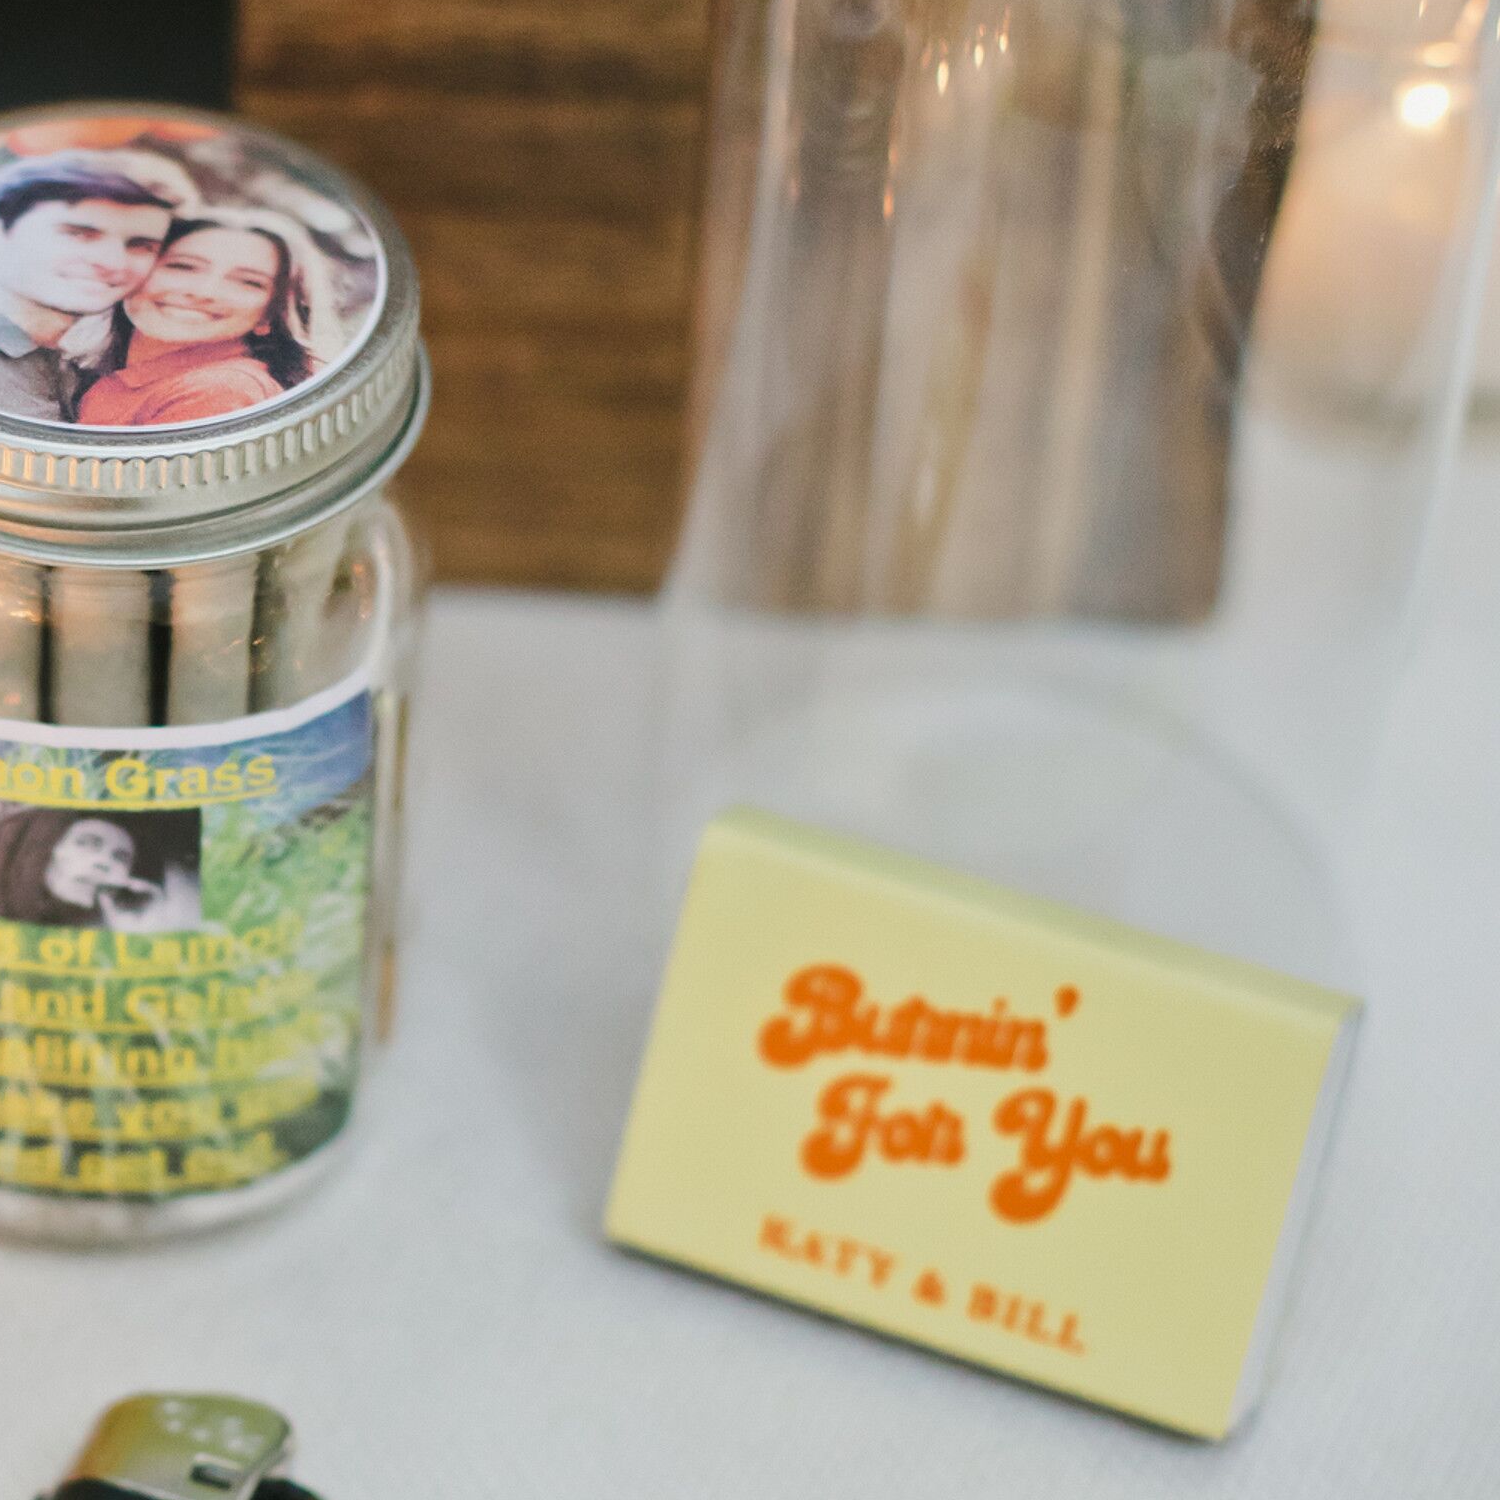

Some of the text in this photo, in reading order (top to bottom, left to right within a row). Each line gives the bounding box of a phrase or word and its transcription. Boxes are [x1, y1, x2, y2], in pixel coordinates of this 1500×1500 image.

[105, 756, 277, 802] Grass
[39, 928, 98, 966] of
[758, 964, 1081, 1071] Burnin'
[800, 1073, 1171, 1225] For You
[759, 1217, 1088, 1355] KATY & BILL
